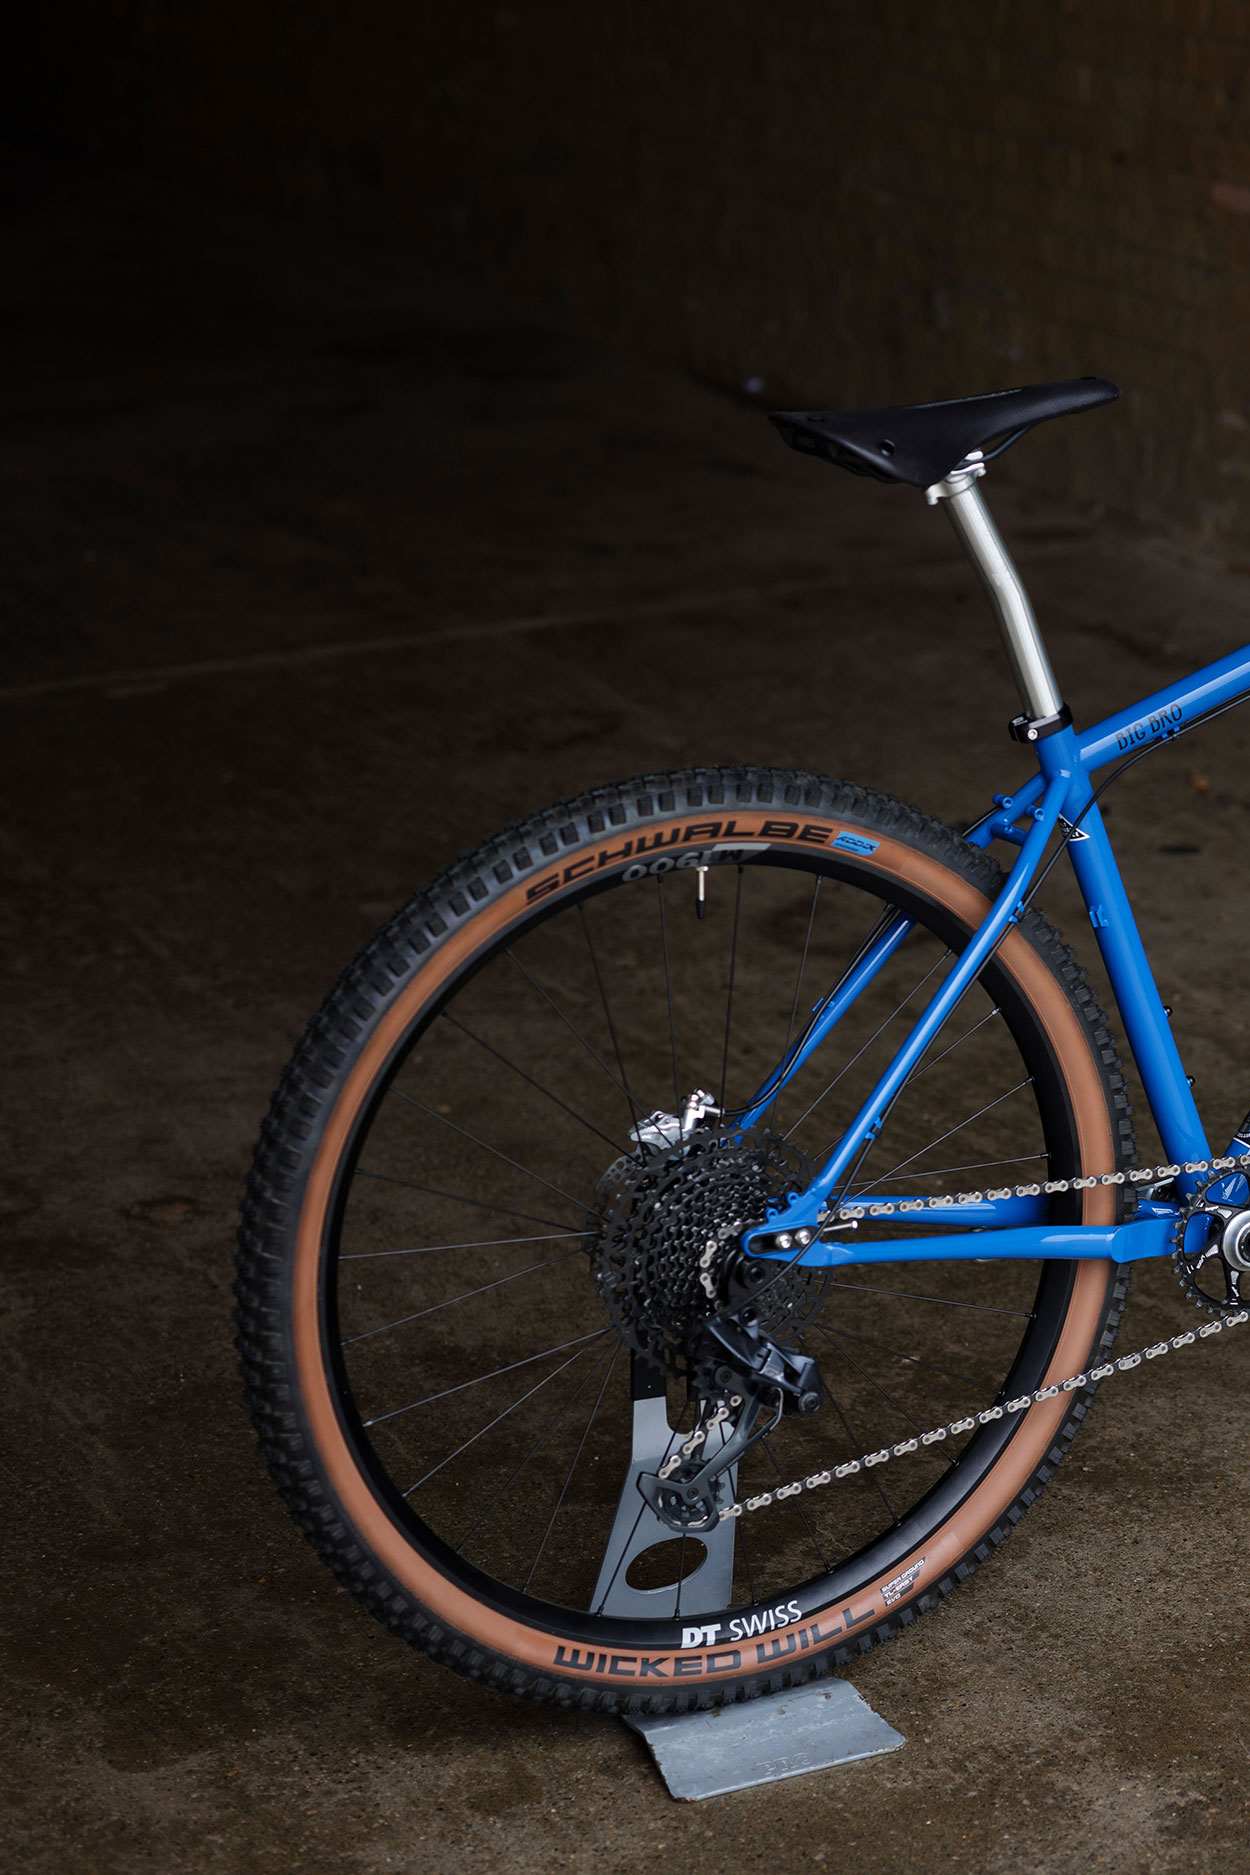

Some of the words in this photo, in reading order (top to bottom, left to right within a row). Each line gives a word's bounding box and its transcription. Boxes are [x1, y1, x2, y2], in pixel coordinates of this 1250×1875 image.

[1115, 724, 1146, 750] BIG
[1147, 703, 1183, 733] BRO
[526, 820, 833, 905] SCHWALBE
[886, 1593, 901, 1605] EVO
[553, 1645, 741, 1677] WICKED
[756, 1607, 875, 1664] WILL
[680, 1623, 721, 1649] DT
[730, 1600, 802, 1642] SWISS
